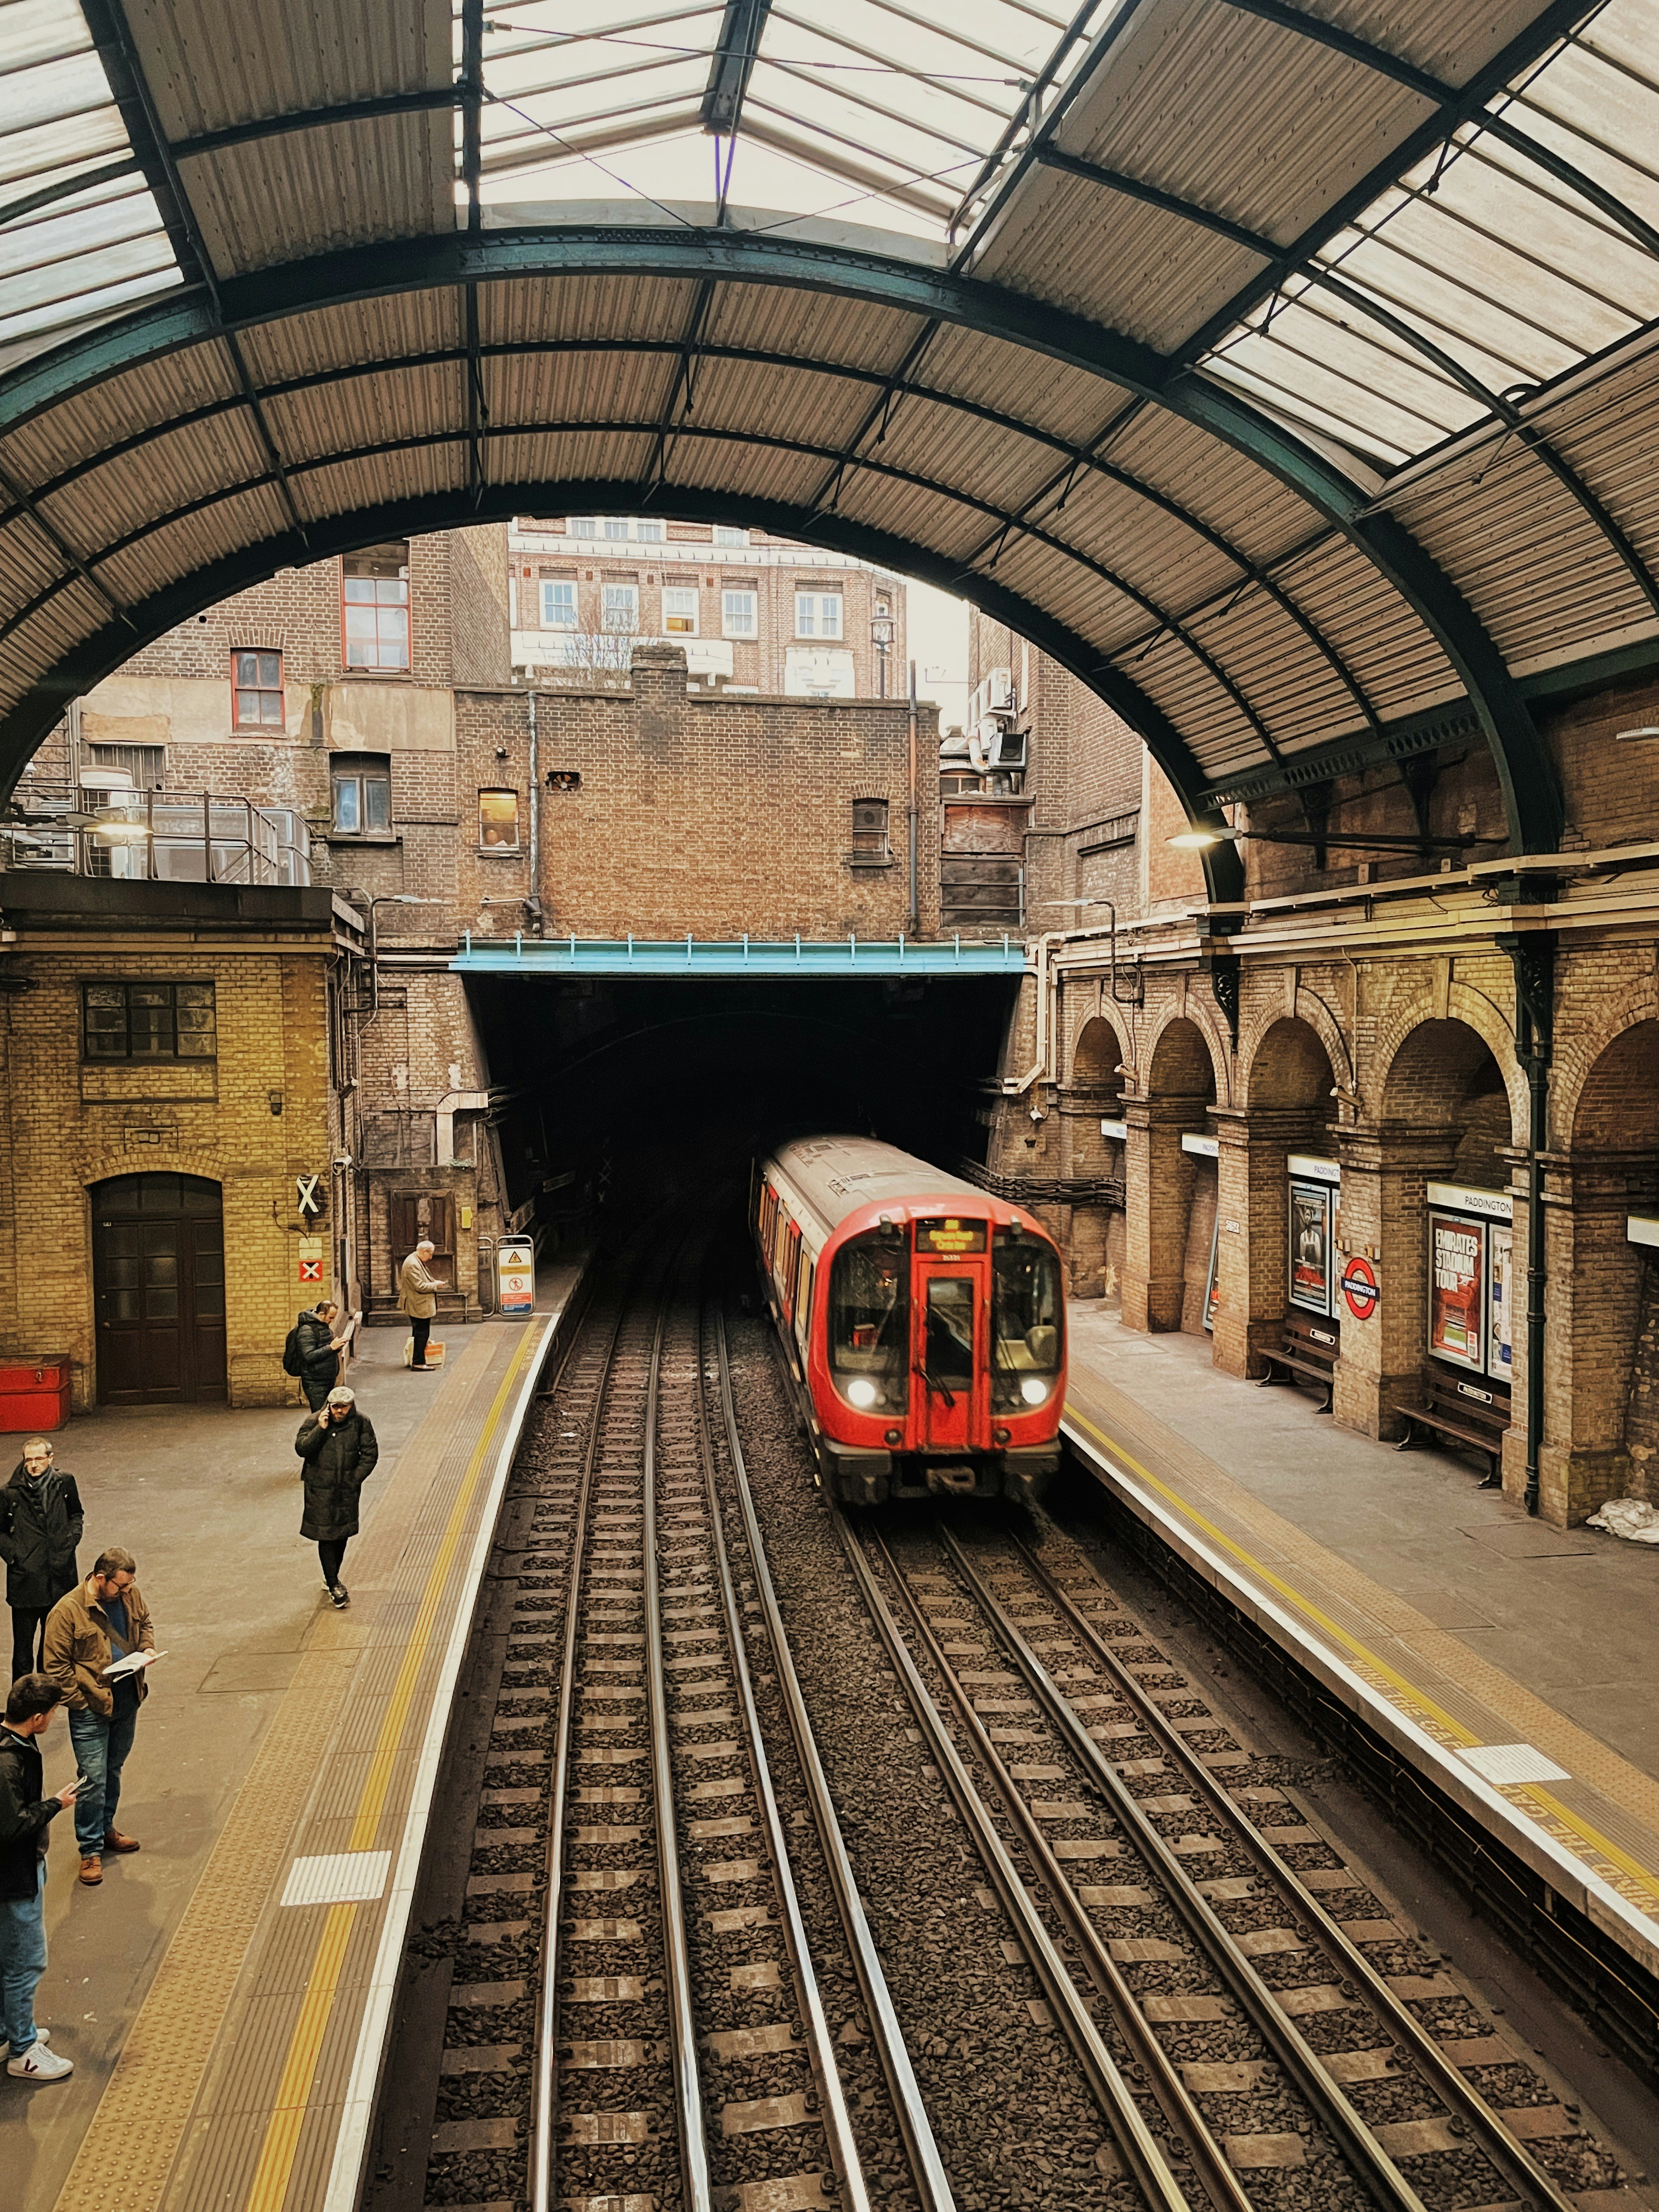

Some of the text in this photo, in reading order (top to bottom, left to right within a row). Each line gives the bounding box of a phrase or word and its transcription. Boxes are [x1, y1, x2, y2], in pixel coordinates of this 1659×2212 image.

[1465, 1196, 1512, 1213] PADDINGTON
[1436, 1228, 1478, 1257] EMIRATES
[1435, 1249, 1475, 1277] STADIUM
[1345, 1280, 1376, 1296] PADDINGTON
[1435, 1268, 1458, 1293] TOUR
[1419, 1720, 1467, 1748] GAP
[1492, 1784, 1549, 1818] GAP
[1539, 1822, 1597, 1859] THE
